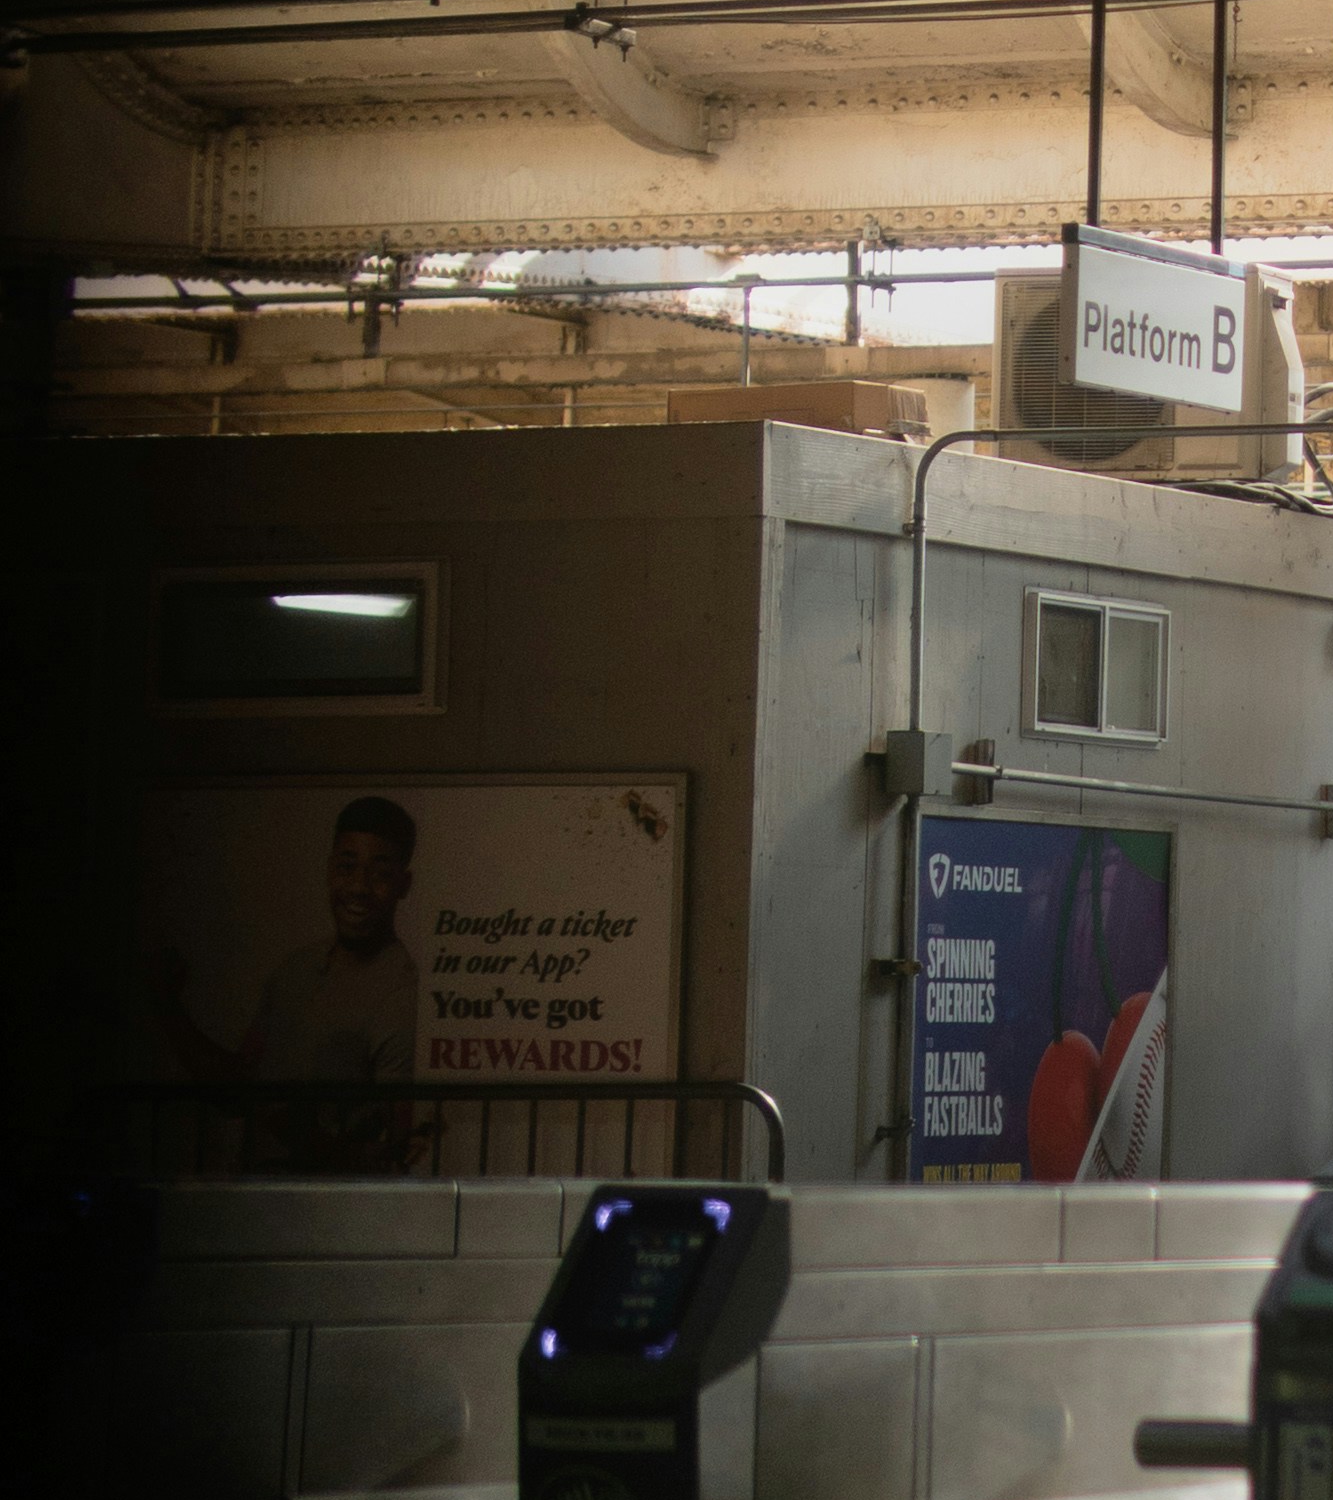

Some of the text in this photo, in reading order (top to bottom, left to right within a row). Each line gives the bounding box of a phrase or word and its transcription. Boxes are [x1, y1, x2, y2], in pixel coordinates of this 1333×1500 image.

[1083, 300, 1237, 375] Platform B
[952, 863, 1023, 894] FANDUEL
[433, 908, 637, 945] Bought a ticket
[431, 947, 592, 983] in our App?
[926, 938, 996, 980] SPINNING
[430, 987, 605, 1031] You've got
[925, 981, 997, 1025] CHERRIES
[428, 1038, 644, 1074] REWARDS!
[924, 1051, 986, 1093] BLAZING
[923, 1094, 1004, 1138] FASTBALLS
